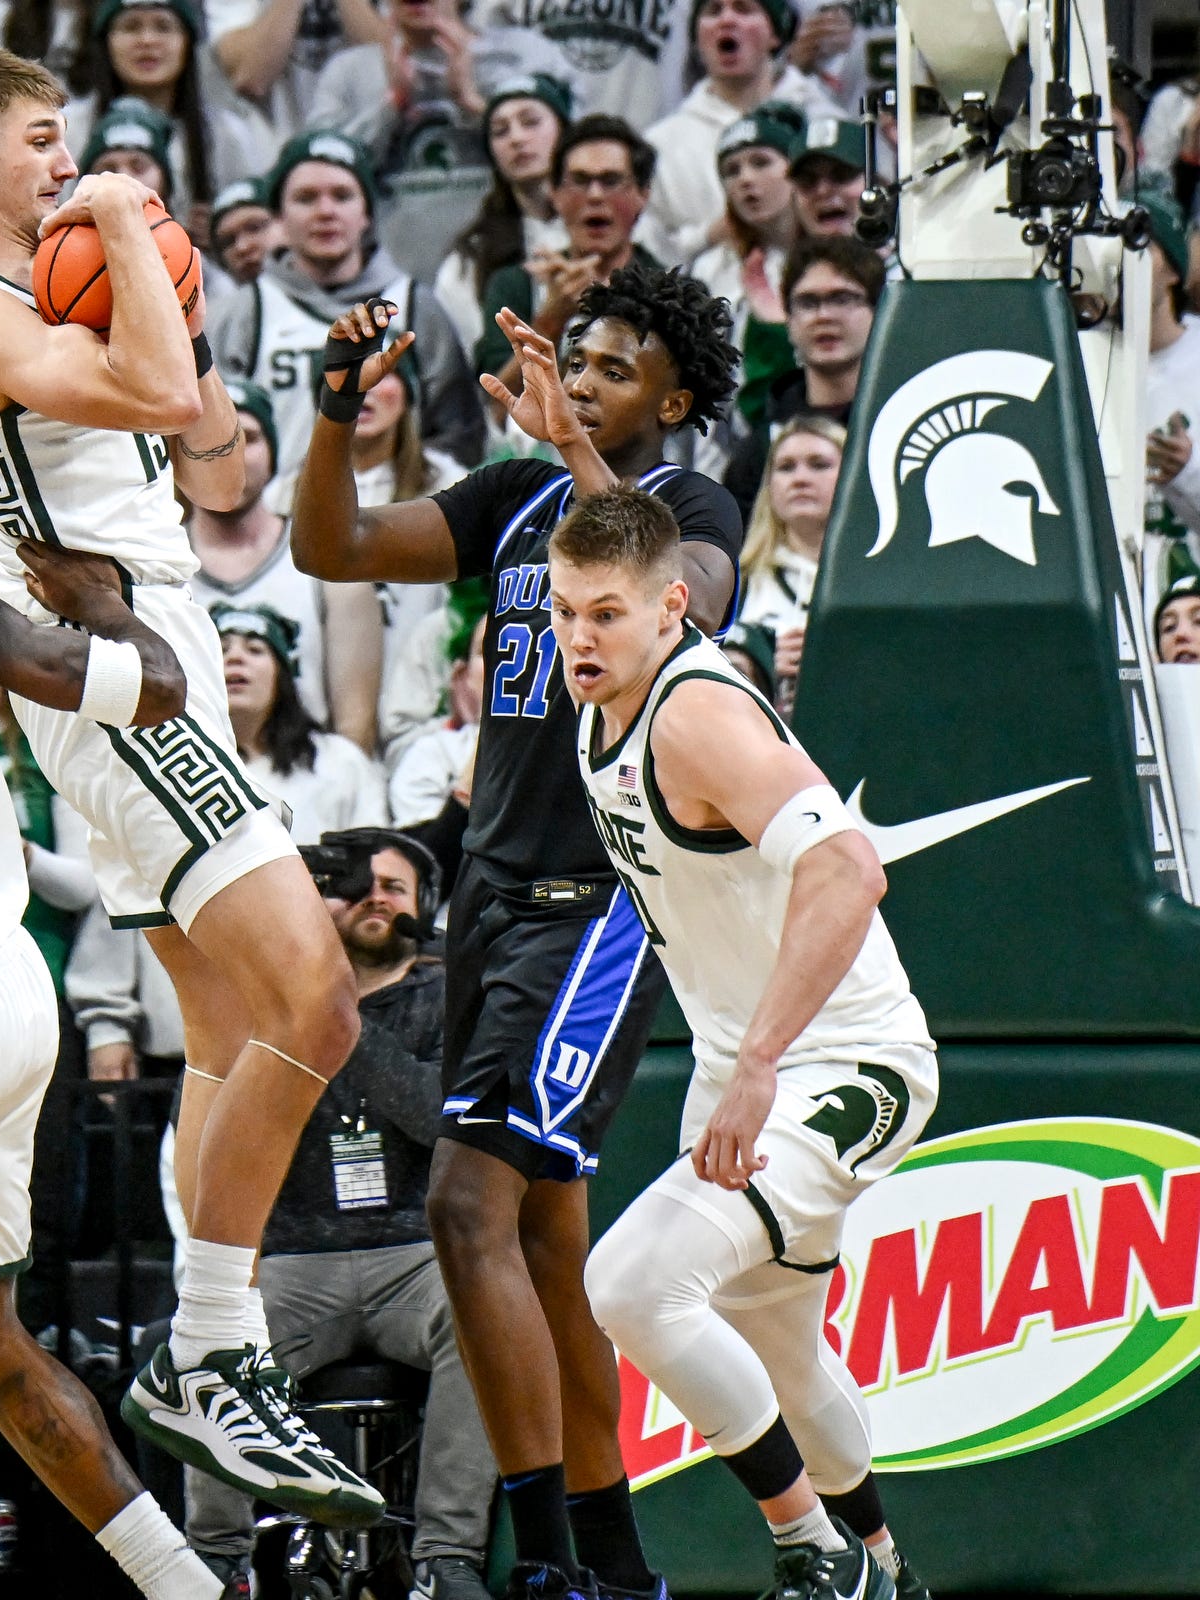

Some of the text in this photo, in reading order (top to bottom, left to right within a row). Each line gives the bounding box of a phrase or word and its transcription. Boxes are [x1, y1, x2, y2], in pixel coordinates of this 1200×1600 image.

[495, 564, 552, 617] DU
[491, 623, 558, 719] 21
[579, 885, 591, 895] 52
[549, 1041, 591, 1089] D
[618, 1171, 1200, 1481] LMAN
